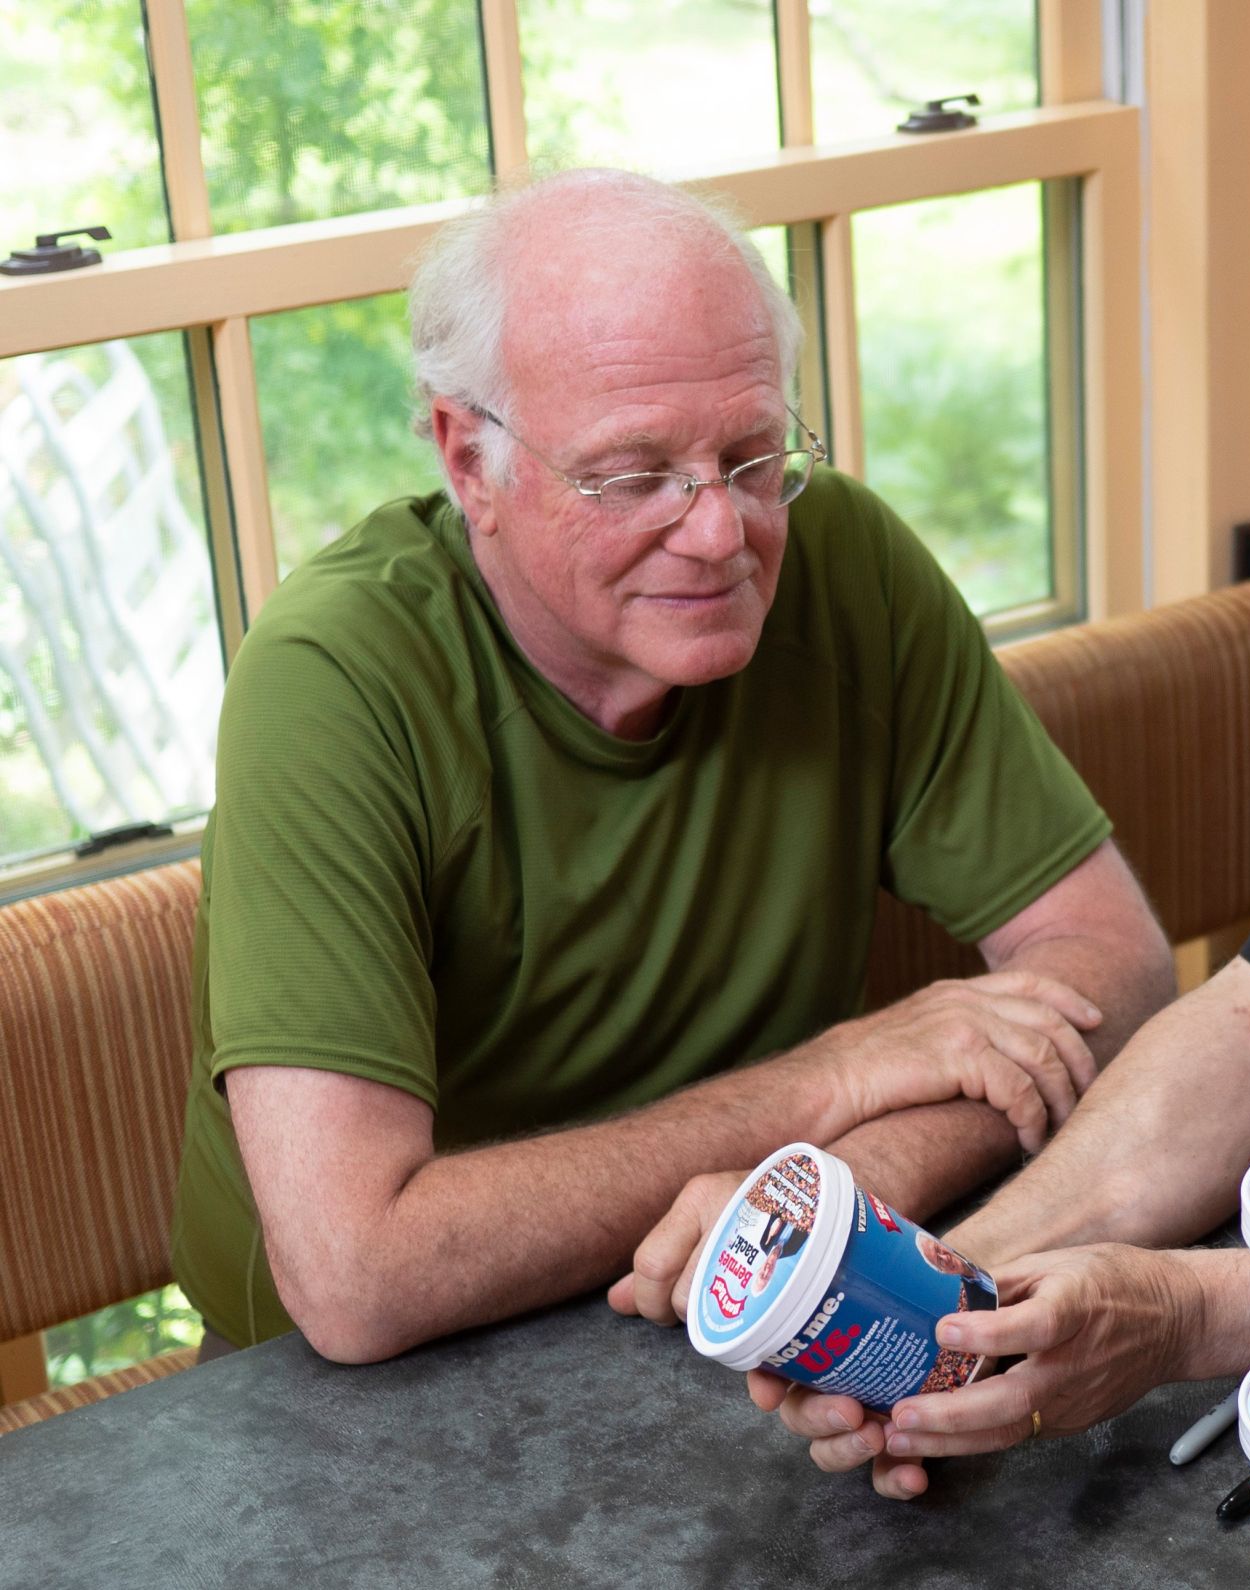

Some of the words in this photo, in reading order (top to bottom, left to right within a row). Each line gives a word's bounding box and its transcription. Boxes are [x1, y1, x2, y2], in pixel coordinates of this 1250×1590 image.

[730, 1235, 759, 1265] Back!
[718, 1250, 753, 1289] Bernie's
[768, 1339, 808, 1367] Not
[803, 1293, 844, 1339] me.
[845, 1358, 860, 1374] soup
[870, 1315, 894, 1340] whack
[860, 1353, 874, 1368] disk
[871, 1341, 884, 1355] into
[878, 1317, 903, 1342] pieces.
[881, 1352, 894, 1366] The
[888, 1330, 911, 1354] butter
[890, 1333, 899, 1342] to
[907, 1331, 917, 1341] to
[797, 1325, 861, 1372] Us.
[885, 1360, 896, 1372] too
[890, 1338, 913, 1362] strong
[899, 1355, 919, 1376] gonna
[912, 1337, 931, 1357] have
[914, 1352, 930, 1368] once
